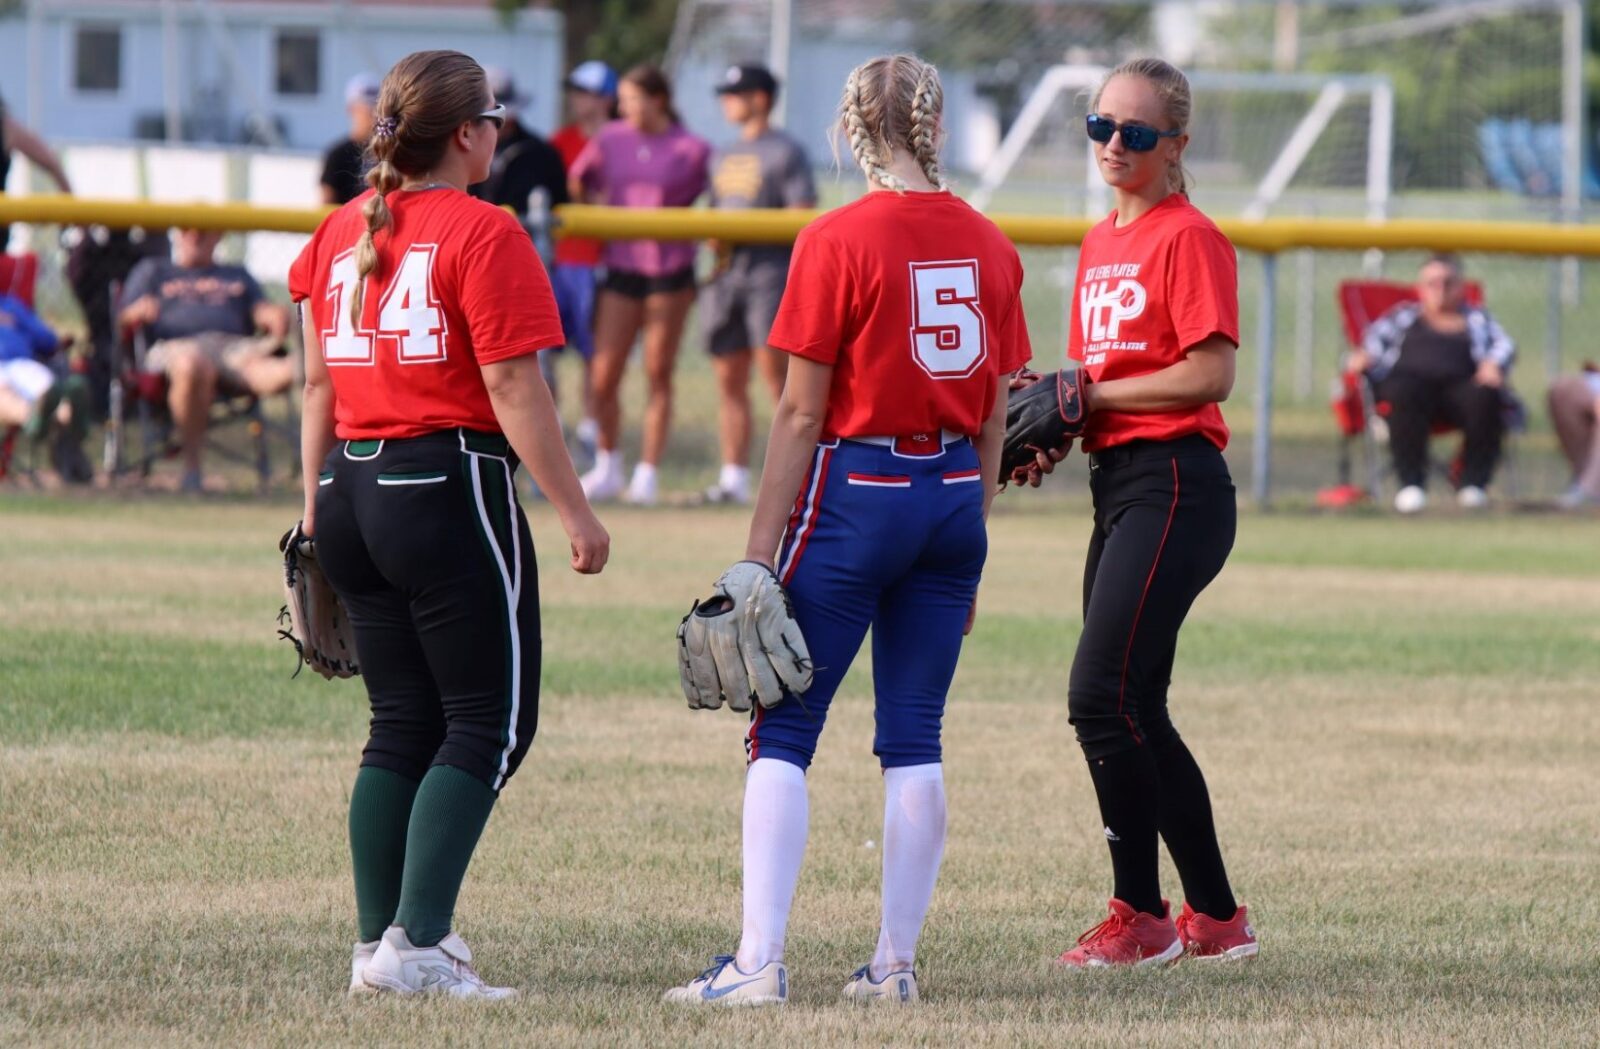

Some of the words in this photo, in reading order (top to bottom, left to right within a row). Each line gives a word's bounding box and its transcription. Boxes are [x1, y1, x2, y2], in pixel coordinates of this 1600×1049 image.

[1111, 263, 1141, 278] PLAYERS
[322, 243, 449, 367] 14
[908, 258, 988, 379] 5
[1111, 341, 1149, 351] GAME
